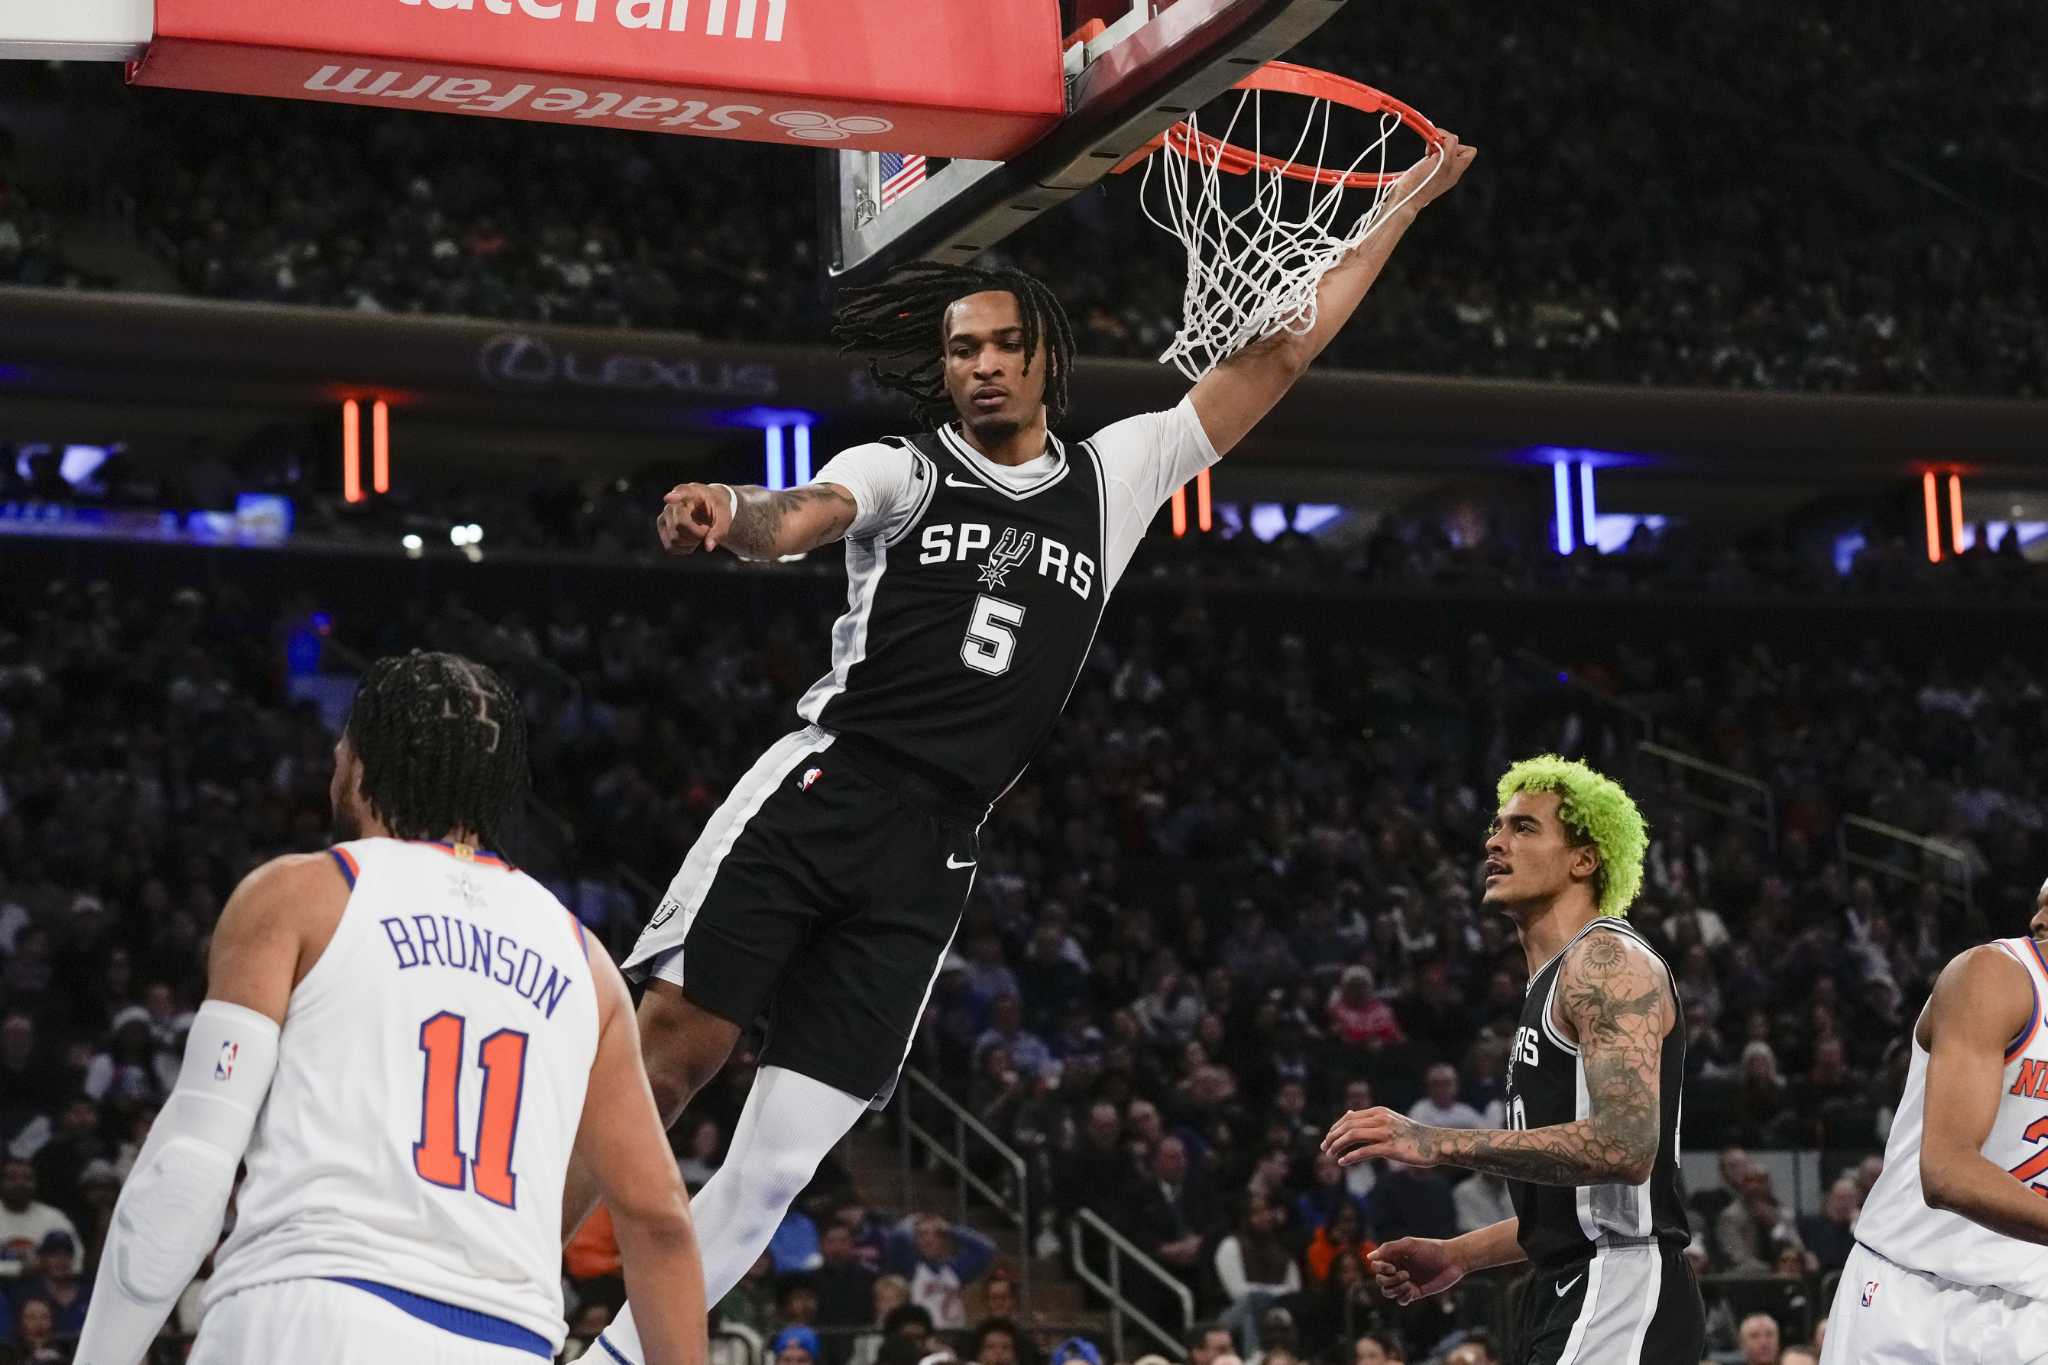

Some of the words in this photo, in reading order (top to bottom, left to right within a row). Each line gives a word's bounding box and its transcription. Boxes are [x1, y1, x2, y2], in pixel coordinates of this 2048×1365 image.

[919, 523, 1095, 600] SPURS
[960, 592, 1027, 677] 5
[380, 915, 572, 1020] BRUNSON
[412, 1010, 529, 1210] 11
